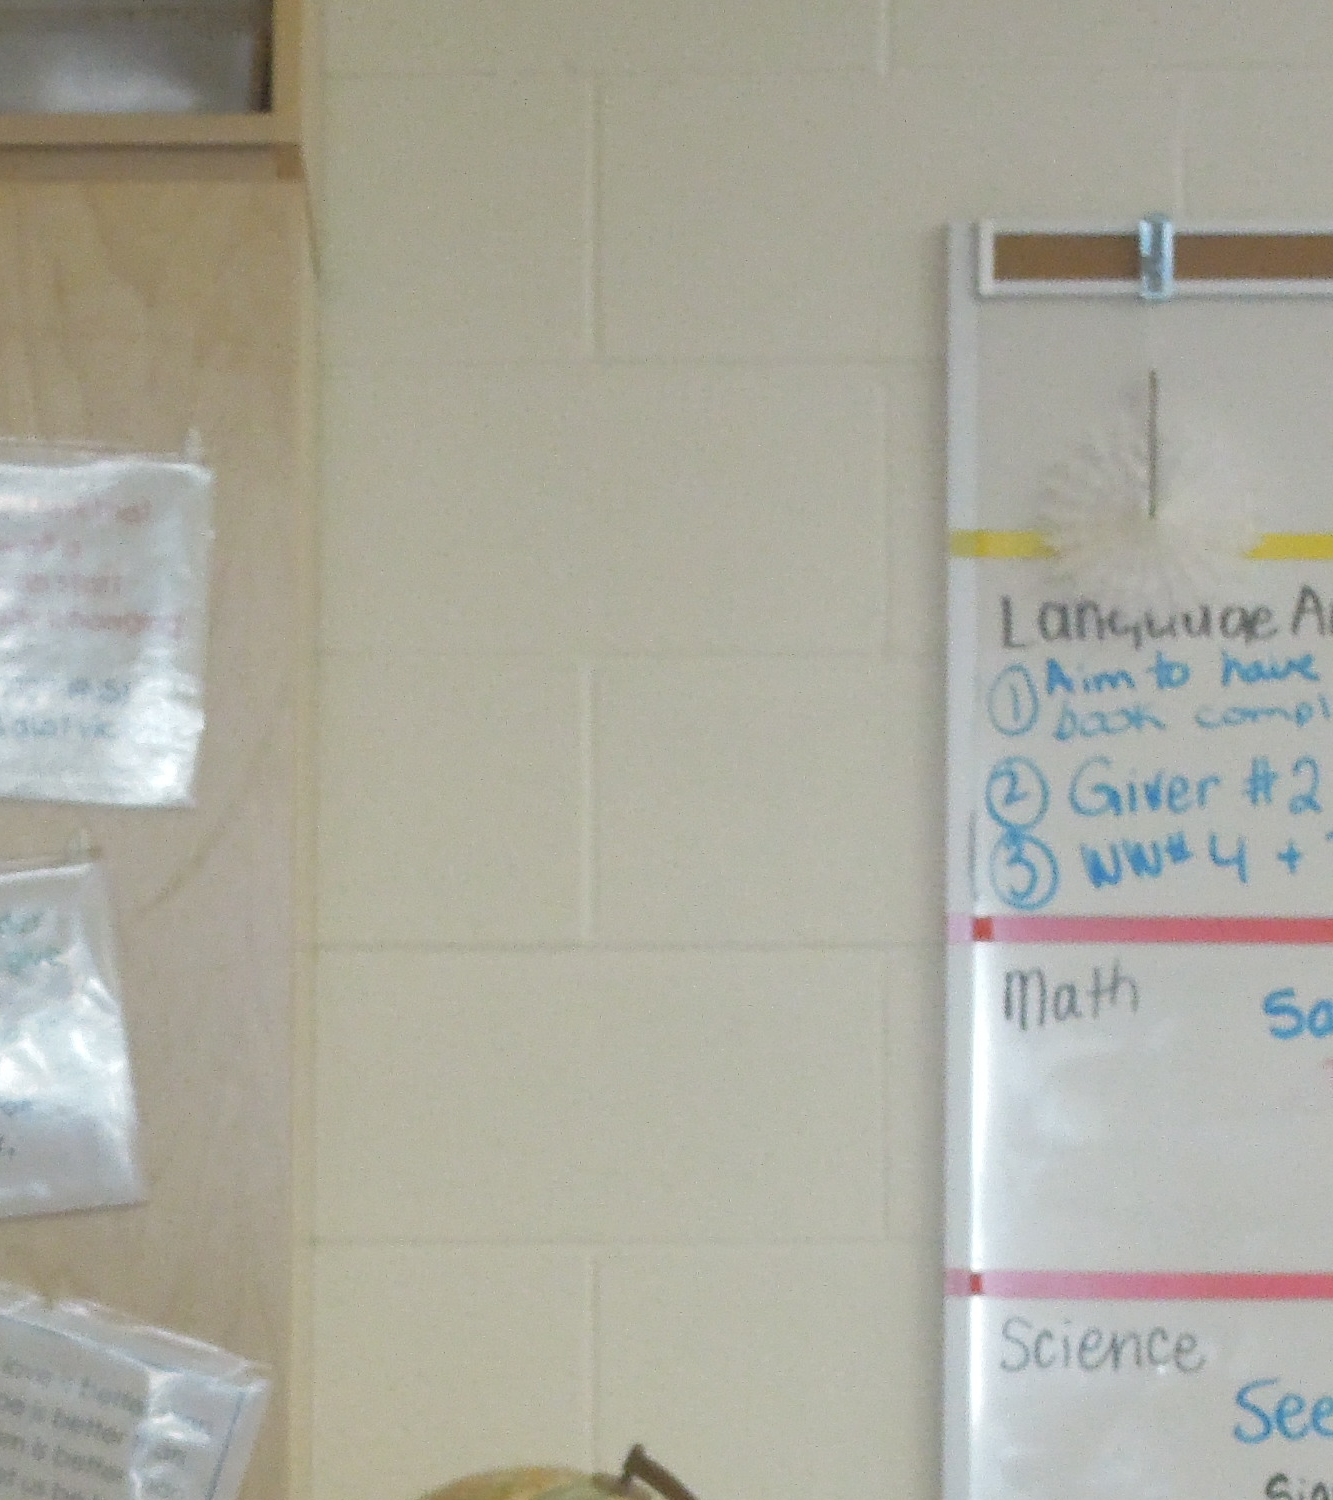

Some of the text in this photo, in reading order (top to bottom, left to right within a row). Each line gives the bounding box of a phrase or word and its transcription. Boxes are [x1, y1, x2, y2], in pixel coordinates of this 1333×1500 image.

[998, 583, 1333, 651] Language A
[1046, 656, 1135, 695] Aim
[1146, 649, 1191, 690] to
[1221, 647, 1321, 688] have
[1052, 699, 1167, 741] book
[1068, 755, 1222, 817] Giver
[1001, 958, 1140, 1033] Math
[999, 1316, 1208, 1375] Science
[52, 1405, 124, 1445] better
